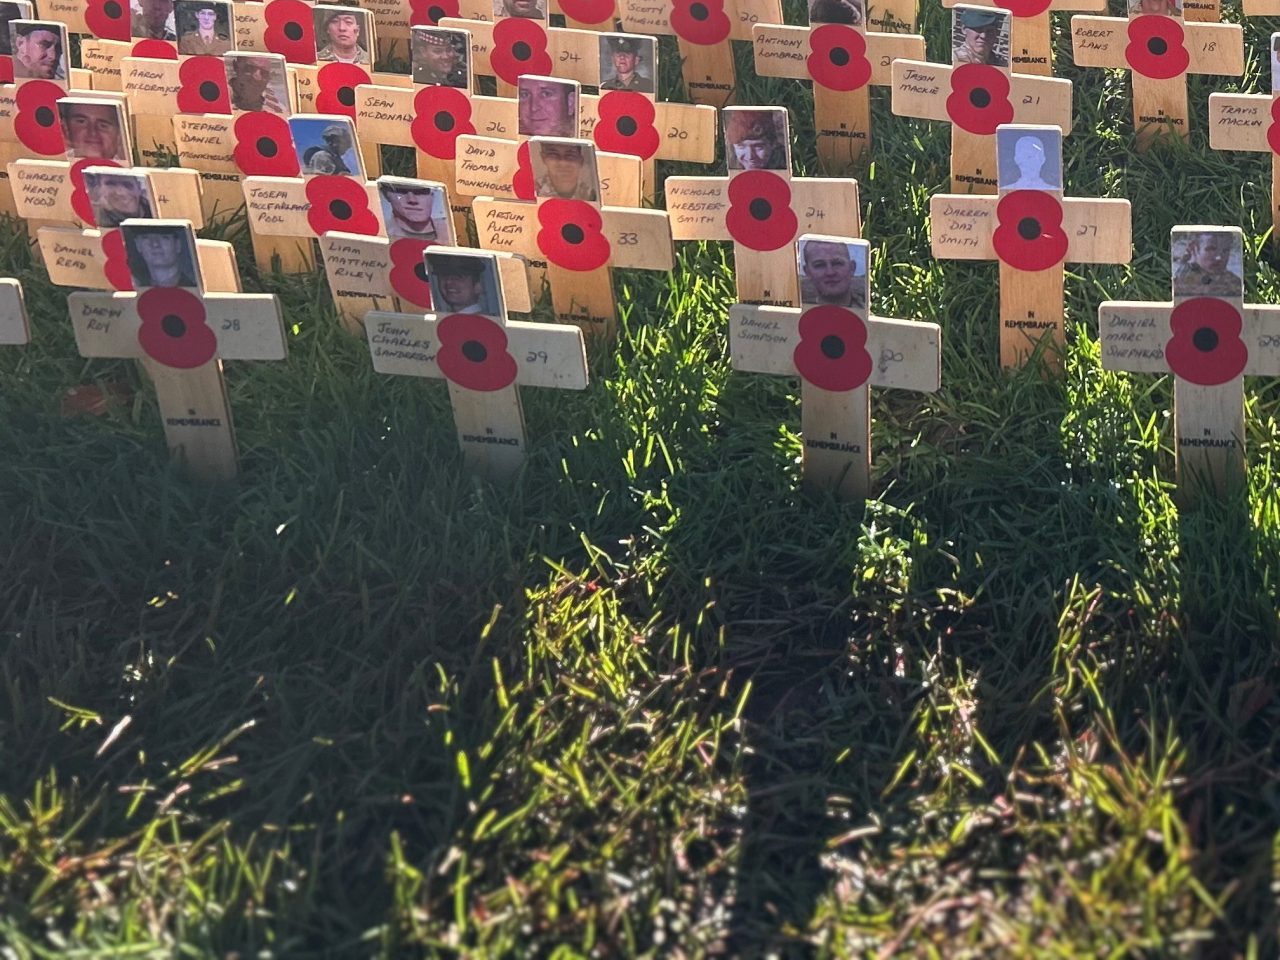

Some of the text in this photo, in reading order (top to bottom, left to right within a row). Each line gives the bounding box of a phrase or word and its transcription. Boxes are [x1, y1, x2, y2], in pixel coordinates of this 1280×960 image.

[628, 16, 668, 26] HUGHES
[740, 12, 758, 22] 20
[1075, 28, 1113, 38] ROBERT
[756, 34, 802, 46] ANTHONY
[1202, 42, 1216, 52] 18
[85, 48, 113, 62] JAMIE
[560, 50, 581, 62] 24
[758, 50, 808, 62] LOMBARDI
[129, 69, 164, 79] AARON
[903, 70, 936, 81] JASON
[689, 81, 731, 91] REMEMBRANCE
[899, 84, 939, 94] MACKIE
[364, 97, 394, 108] SEAN
[1022, 95, 1040, 105] 21
[1221, 105, 1258, 114] TRAVIS
[358, 111, 414, 122] MCDONALD
[1218, 117, 1262, 127] MACKIN
[181, 121, 228, 133] STEPHEN
[486, 122, 506, 133] 26
[667, 127, 687, 139] 20
[821, 129, 866, 139] REMEMBRANCE
[181, 134, 221, 144] DANIEL
[465, 144, 496, 157] DAVID
[178, 151, 235, 162] MONKHOUSE
[461, 160, 499, 172] THOMAS
[18, 171, 64, 184] CHARLES
[23, 186, 59, 196] HENRY
[457, 179, 514, 192] MONKHOUSE
[250, 188, 288, 199] JOSEPH
[671, 188, 722, 197] NICHOLAS
[258, 213, 284, 223] POOL
[486, 209, 525, 221] ARJUN
[677, 215, 715, 223] SMITH
[805, 208, 825, 219] 24
[943, 209, 990, 218] DARREN
[487, 222, 523, 234] PURJA
[1077, 226, 1097, 236] 27
[490, 233, 514, 246] PUN
[617, 233, 637, 245] 33
[939, 236, 979, 247] SMITH
[54, 243, 93, 258] DANIEL
[329, 243, 360, 255] LIAM
[55, 258, 86, 270] READ
[334, 268, 373, 281] RILEY
[86, 320, 111, 333] ROY
[222, 319, 240, 331] 28
[740, 316, 780, 330] DANIEL
[1005, 320, 1058, 329] REMEMBRANCE
[1107, 314, 1156, 328] DANIEL
[378, 323, 410, 336] JOHN
[738, 329, 788, 343] SIMPSON
[1105, 333, 1143, 342] MARC
[1259, 335, 1280, 347] 28
[372, 335, 431, 349] CHARLES
[374, 348, 436, 362] SANDERSON
[526, 351, 548, 363] 29
[1106, 345, 1164, 360] SHEPHERD
[166, 418, 221, 427] REMEMBRANCE
[1204, 428, 1210, 436] IN
[463, 434, 519, 446] REMEMBRANCE
[1179, 438, 1236, 448] REMEMBRANCE
[807, 440, 860, 453] REMEMBRANCE
